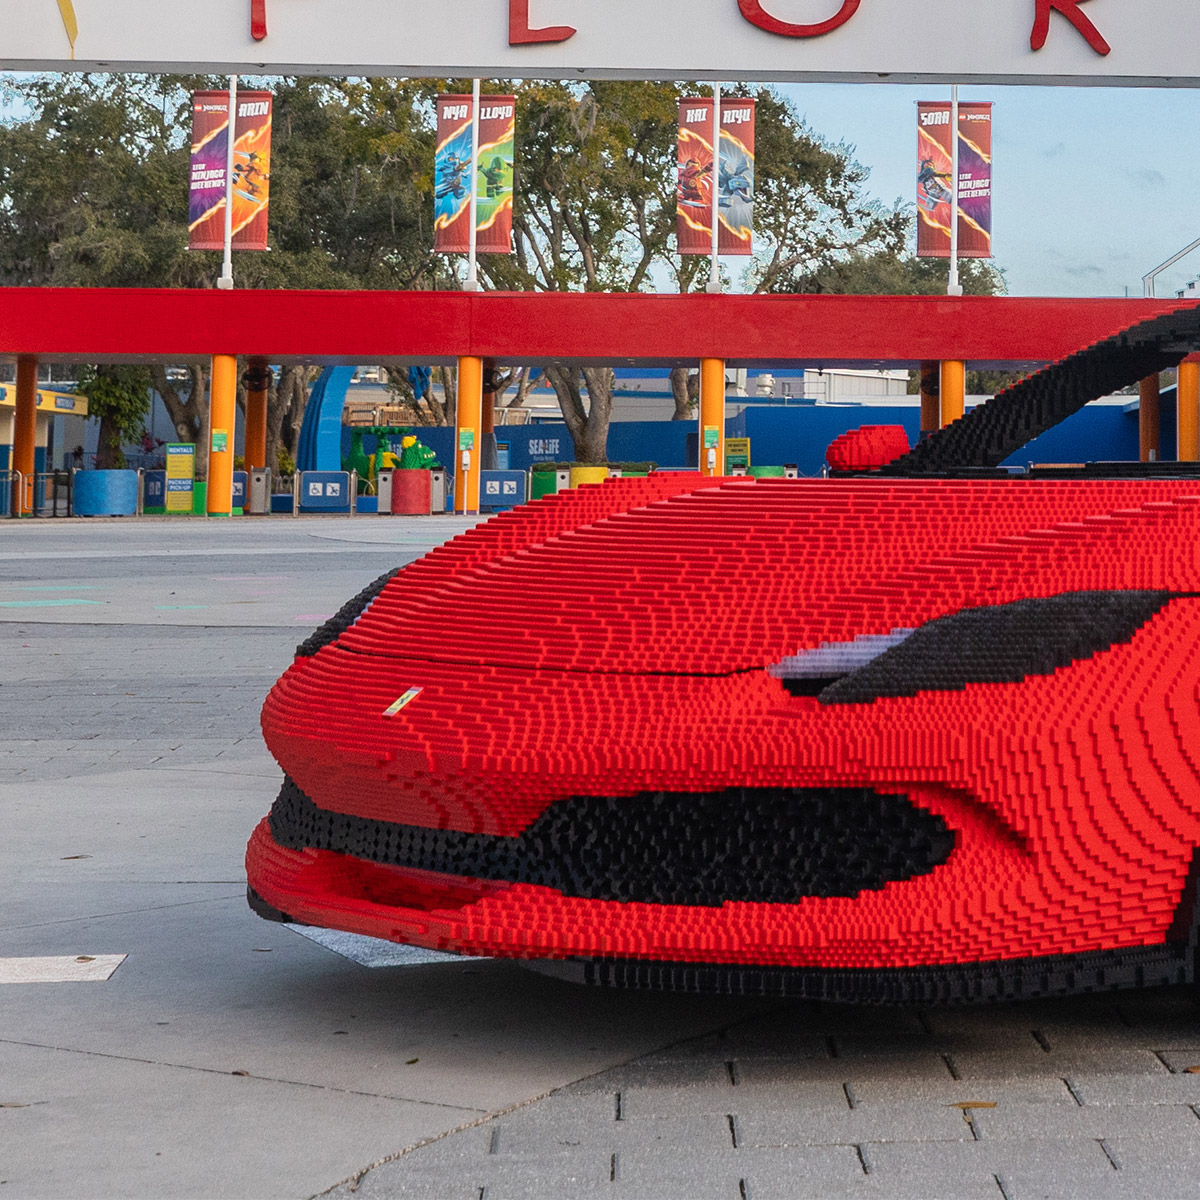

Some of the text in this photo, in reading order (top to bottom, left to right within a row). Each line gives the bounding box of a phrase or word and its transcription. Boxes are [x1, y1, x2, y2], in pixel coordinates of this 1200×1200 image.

[238, 101, 269, 117] ARIN
[442, 104, 468, 120] NYA
[480, 105, 513, 120] LLOYD
[685, 107, 708, 123] KAI
[920, 111, 950, 126] SORA
[528, 438, 544, 455] SEA
